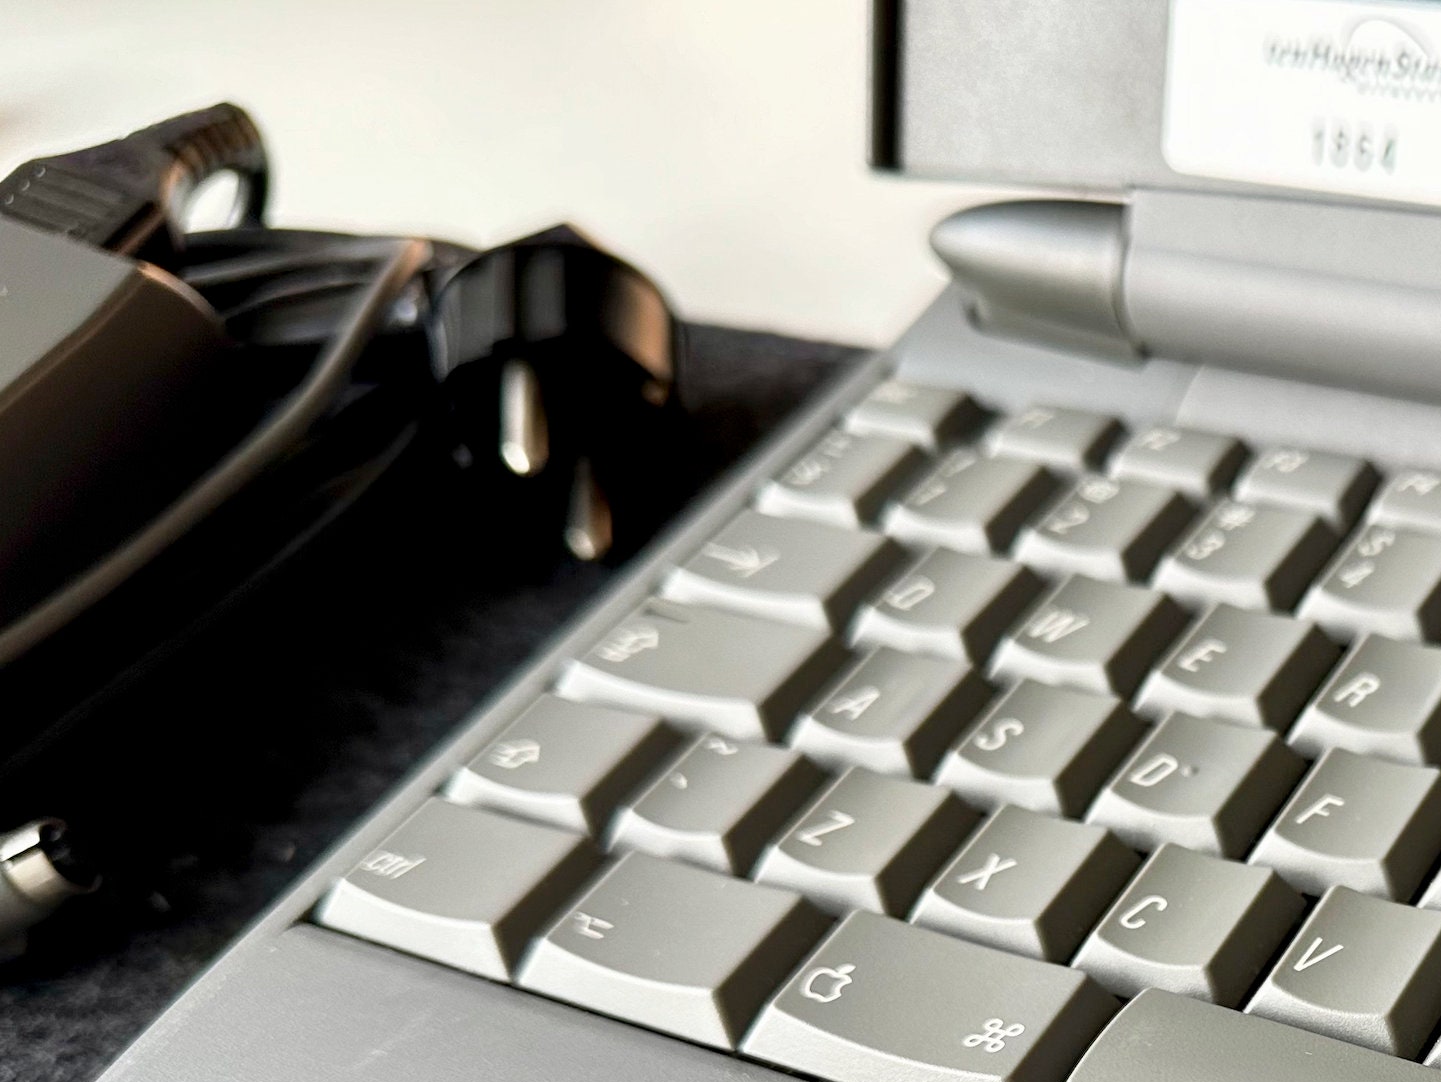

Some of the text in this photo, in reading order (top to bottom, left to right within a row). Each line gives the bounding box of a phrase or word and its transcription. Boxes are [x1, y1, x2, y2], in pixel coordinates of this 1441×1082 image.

[1186, 530, 1226, 560] 3
[1028, 608, 1091, 644] W
[1178, 639, 1228, 673] E
[831, 685, 882, 720] A
[1334, 671, 1381, 708] R
[975, 717, 1025, 751] S
[1129, 753, 1180, 787] D
[1296, 793, 1346, 825] F
[799, 810, 855, 847] Z
[361, 850, 427, 879] ctrl
[957, 853, 1018, 890] X
[1119, 894, 1168, 930] C
[1293, 936, 1345, 972] V
